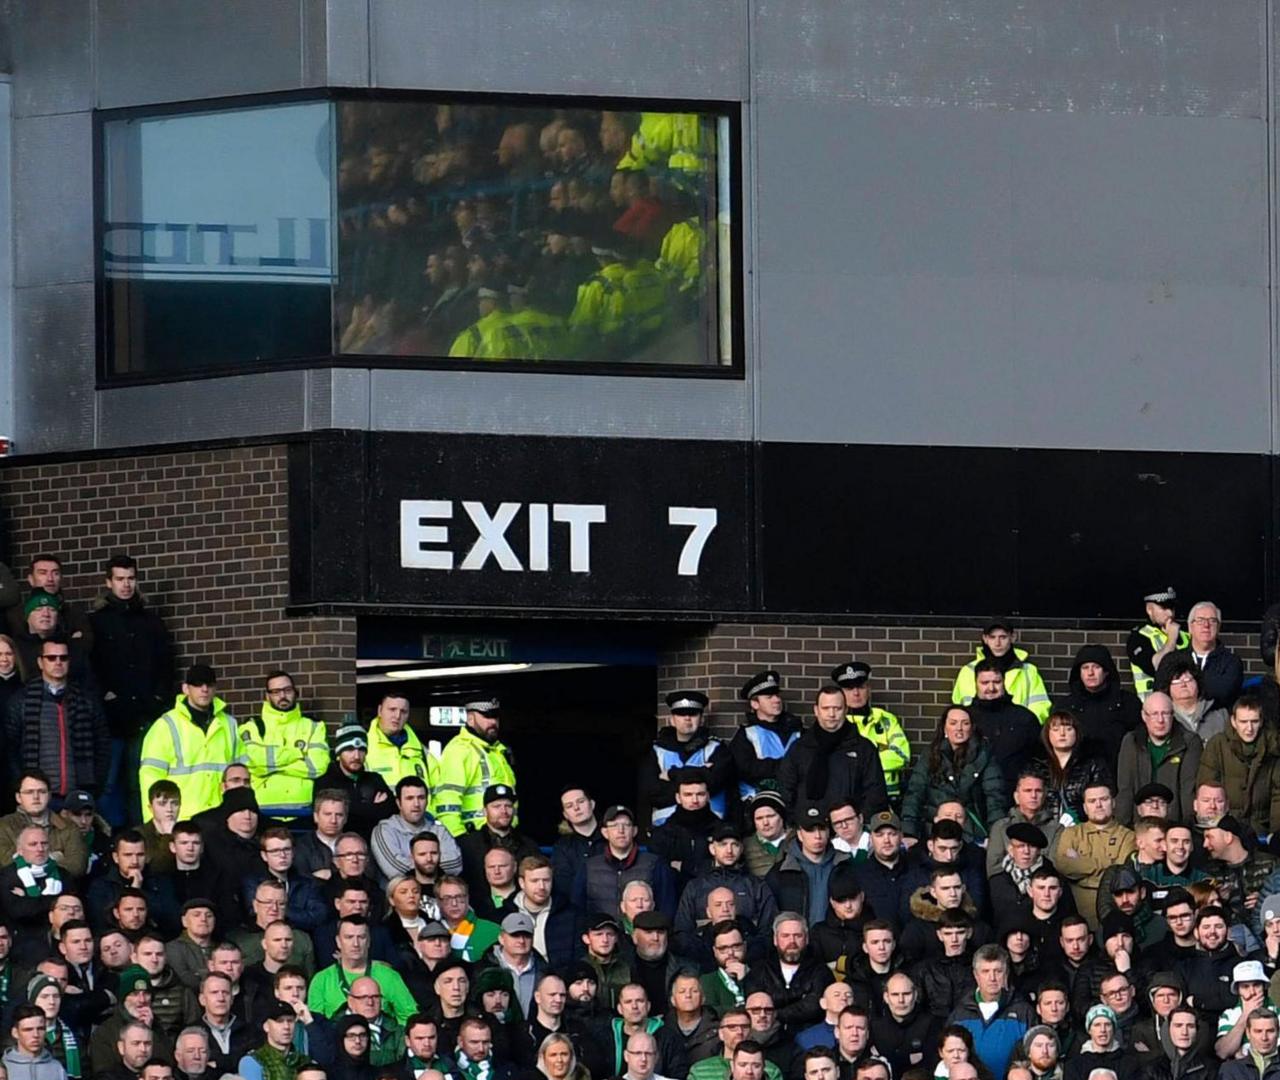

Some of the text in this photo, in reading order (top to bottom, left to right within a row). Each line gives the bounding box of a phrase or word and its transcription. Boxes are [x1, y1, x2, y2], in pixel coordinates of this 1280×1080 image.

[400, 499, 718, 577] EXIT 7
[468, 637, 509, 658] EXIT
